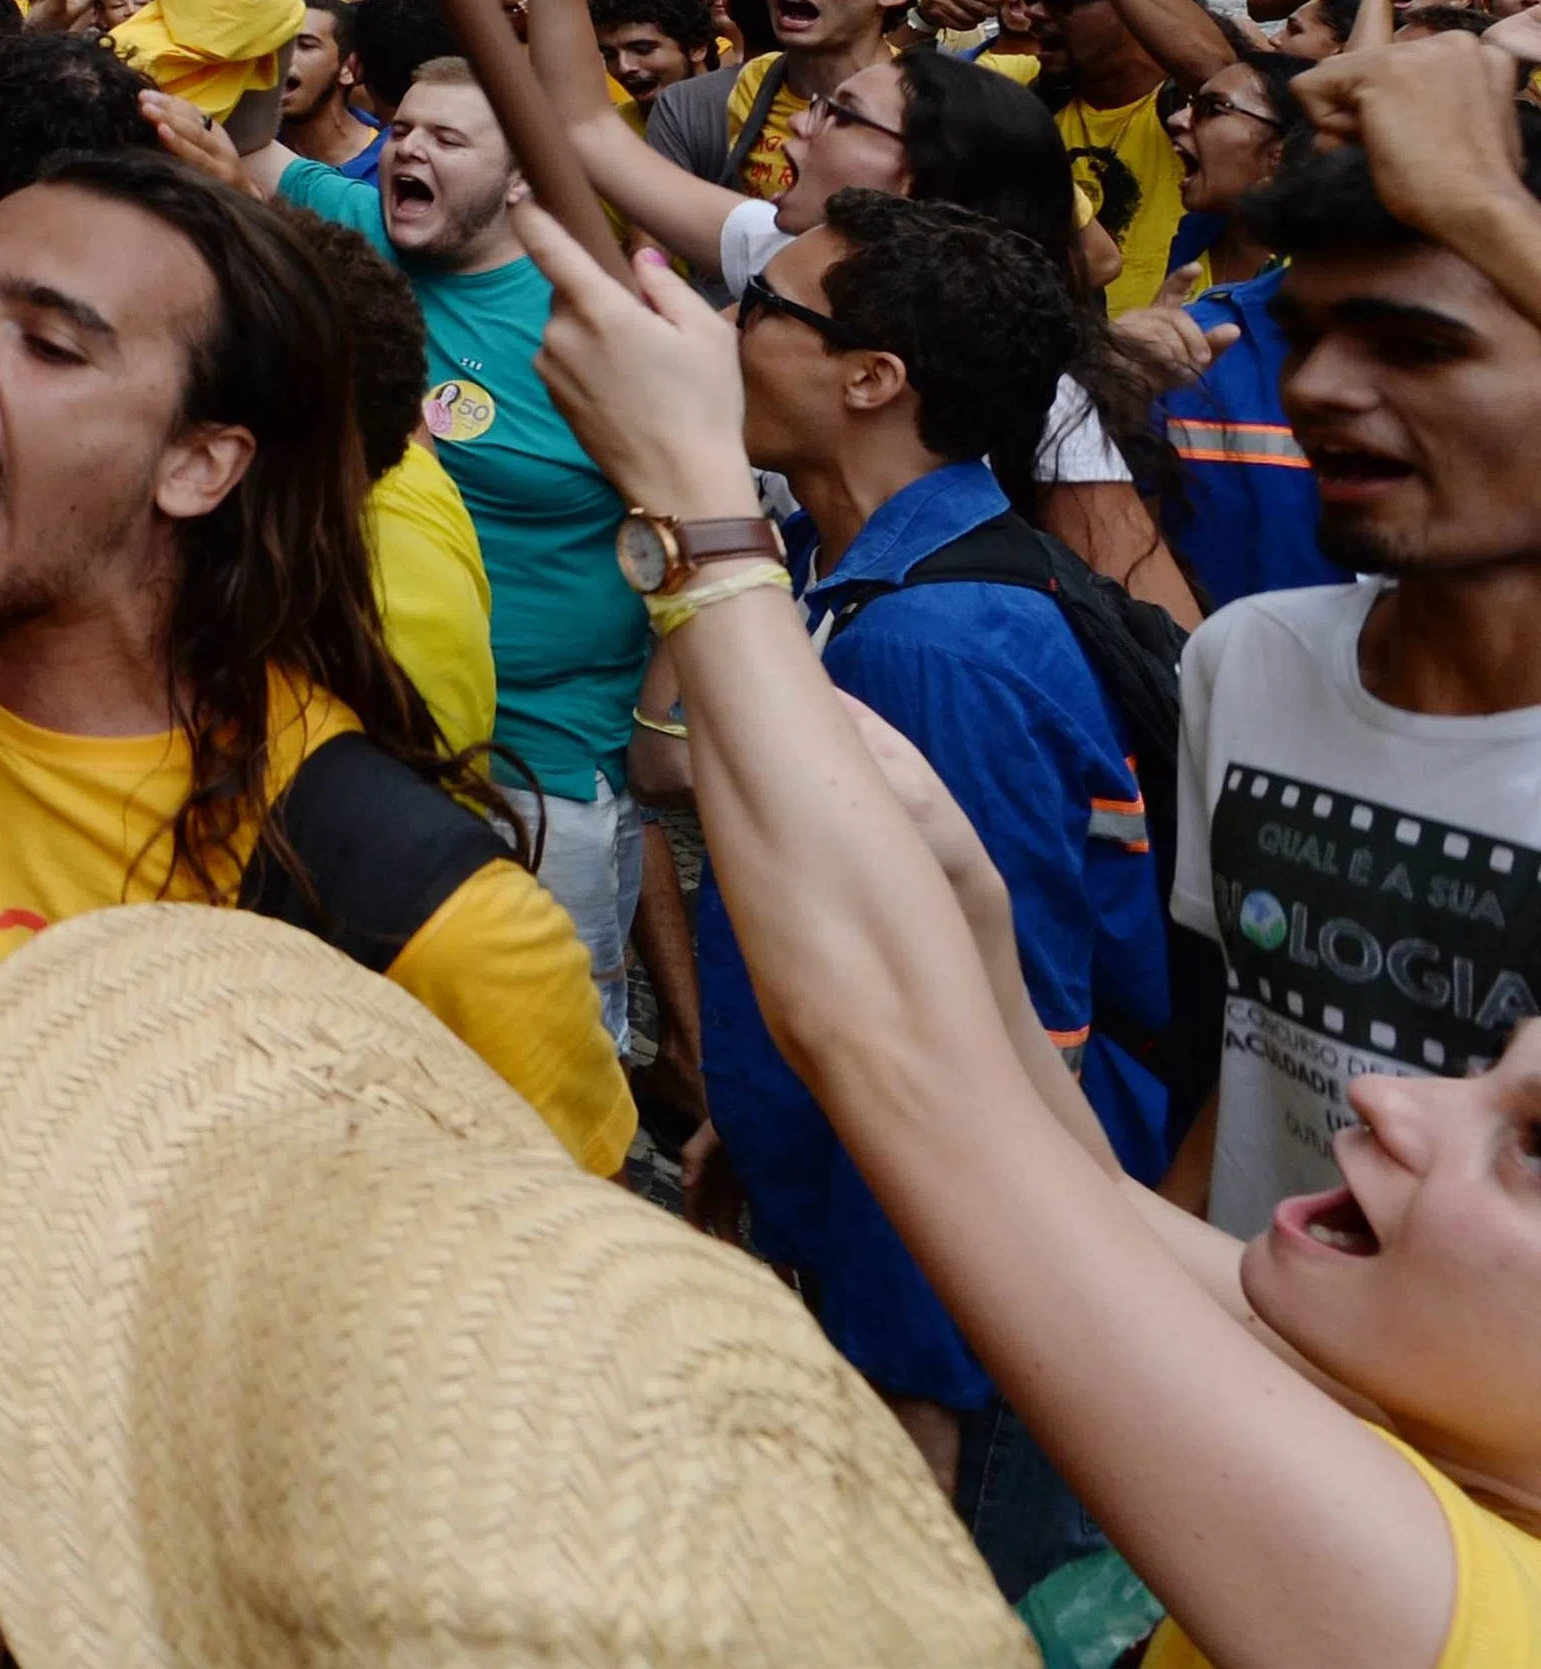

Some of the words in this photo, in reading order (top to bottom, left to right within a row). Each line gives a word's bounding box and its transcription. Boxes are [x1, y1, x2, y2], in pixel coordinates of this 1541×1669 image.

[457, 397, 490, 422] 50
[1257, 821, 1340, 875] QUAL
[1380, 862, 1414, 901] A
[1427, 873, 1506, 930] SUA
[1225, 1029, 1340, 1105] ACULDADE
